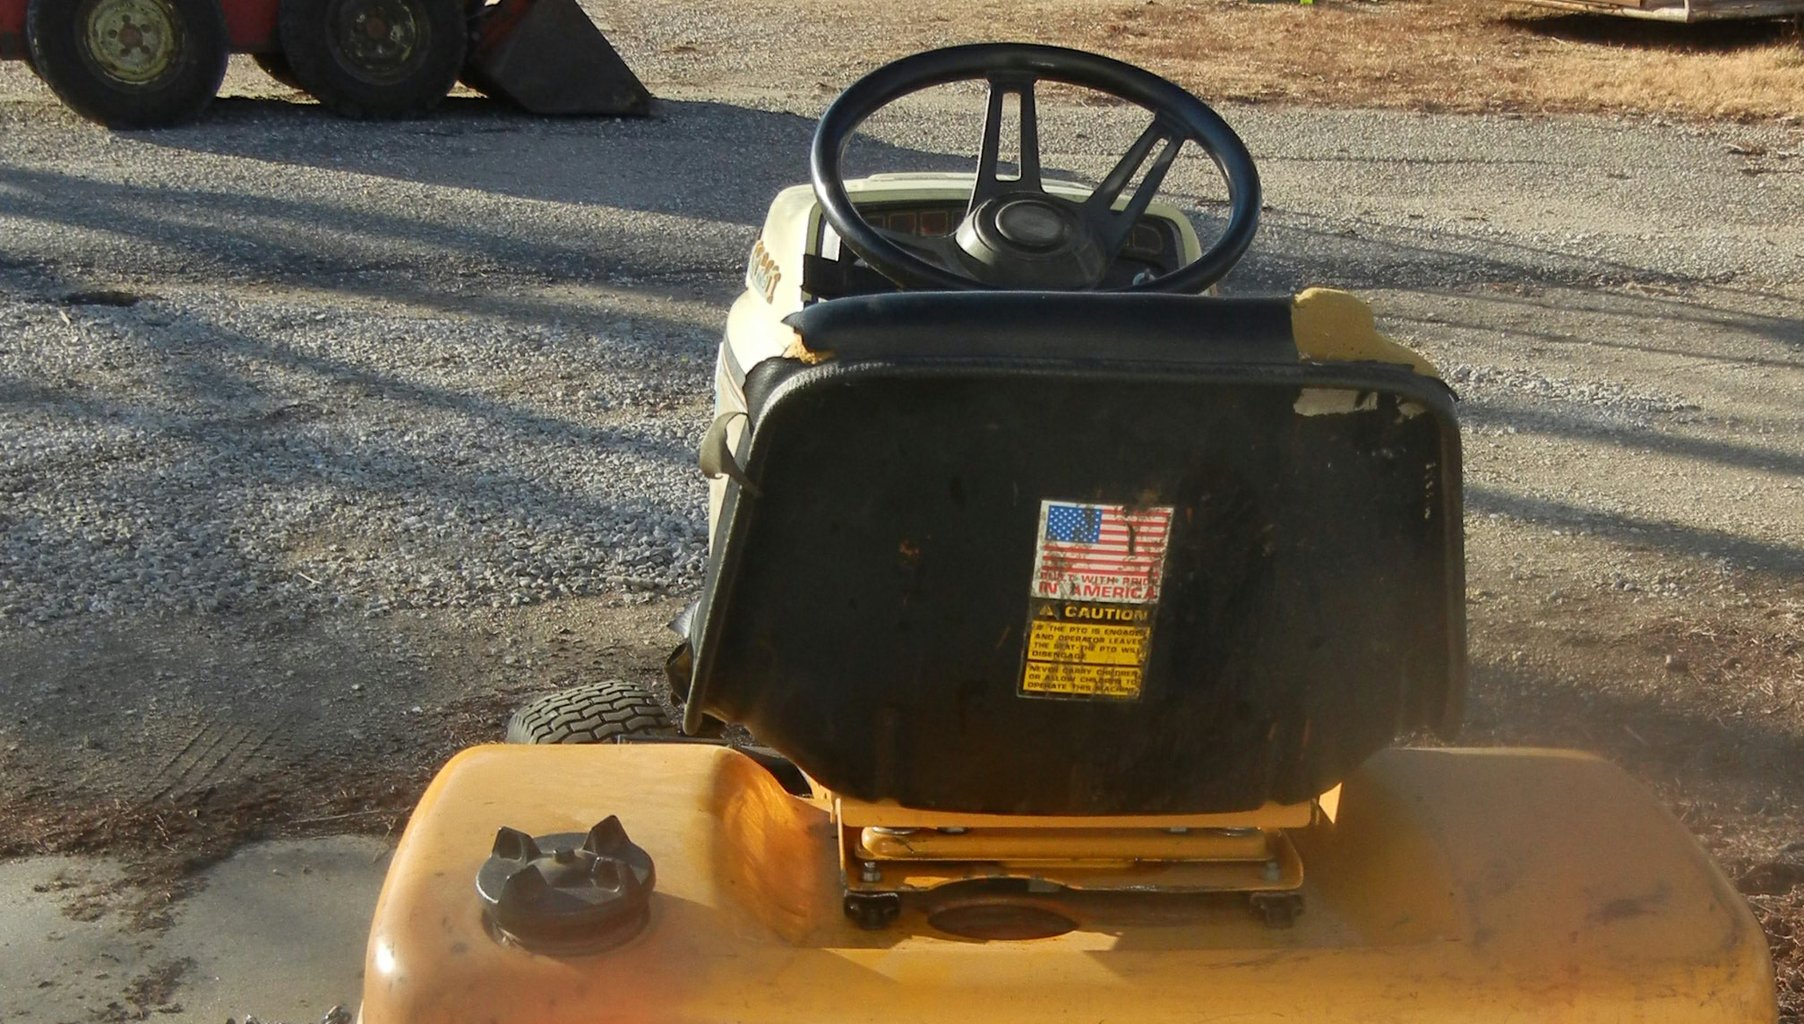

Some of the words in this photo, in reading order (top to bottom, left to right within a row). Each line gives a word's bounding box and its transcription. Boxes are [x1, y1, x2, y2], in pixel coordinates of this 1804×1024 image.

[1081, 575, 1118, 586] WITH
[1069, 583, 1158, 600] AMERICA
[1064, 605, 1148, 621] CAUTION
[1035, 633, 1054, 641] AND
[1058, 635, 1105, 644] OPERATOR
[1099, 645, 1117, 653] PTO
